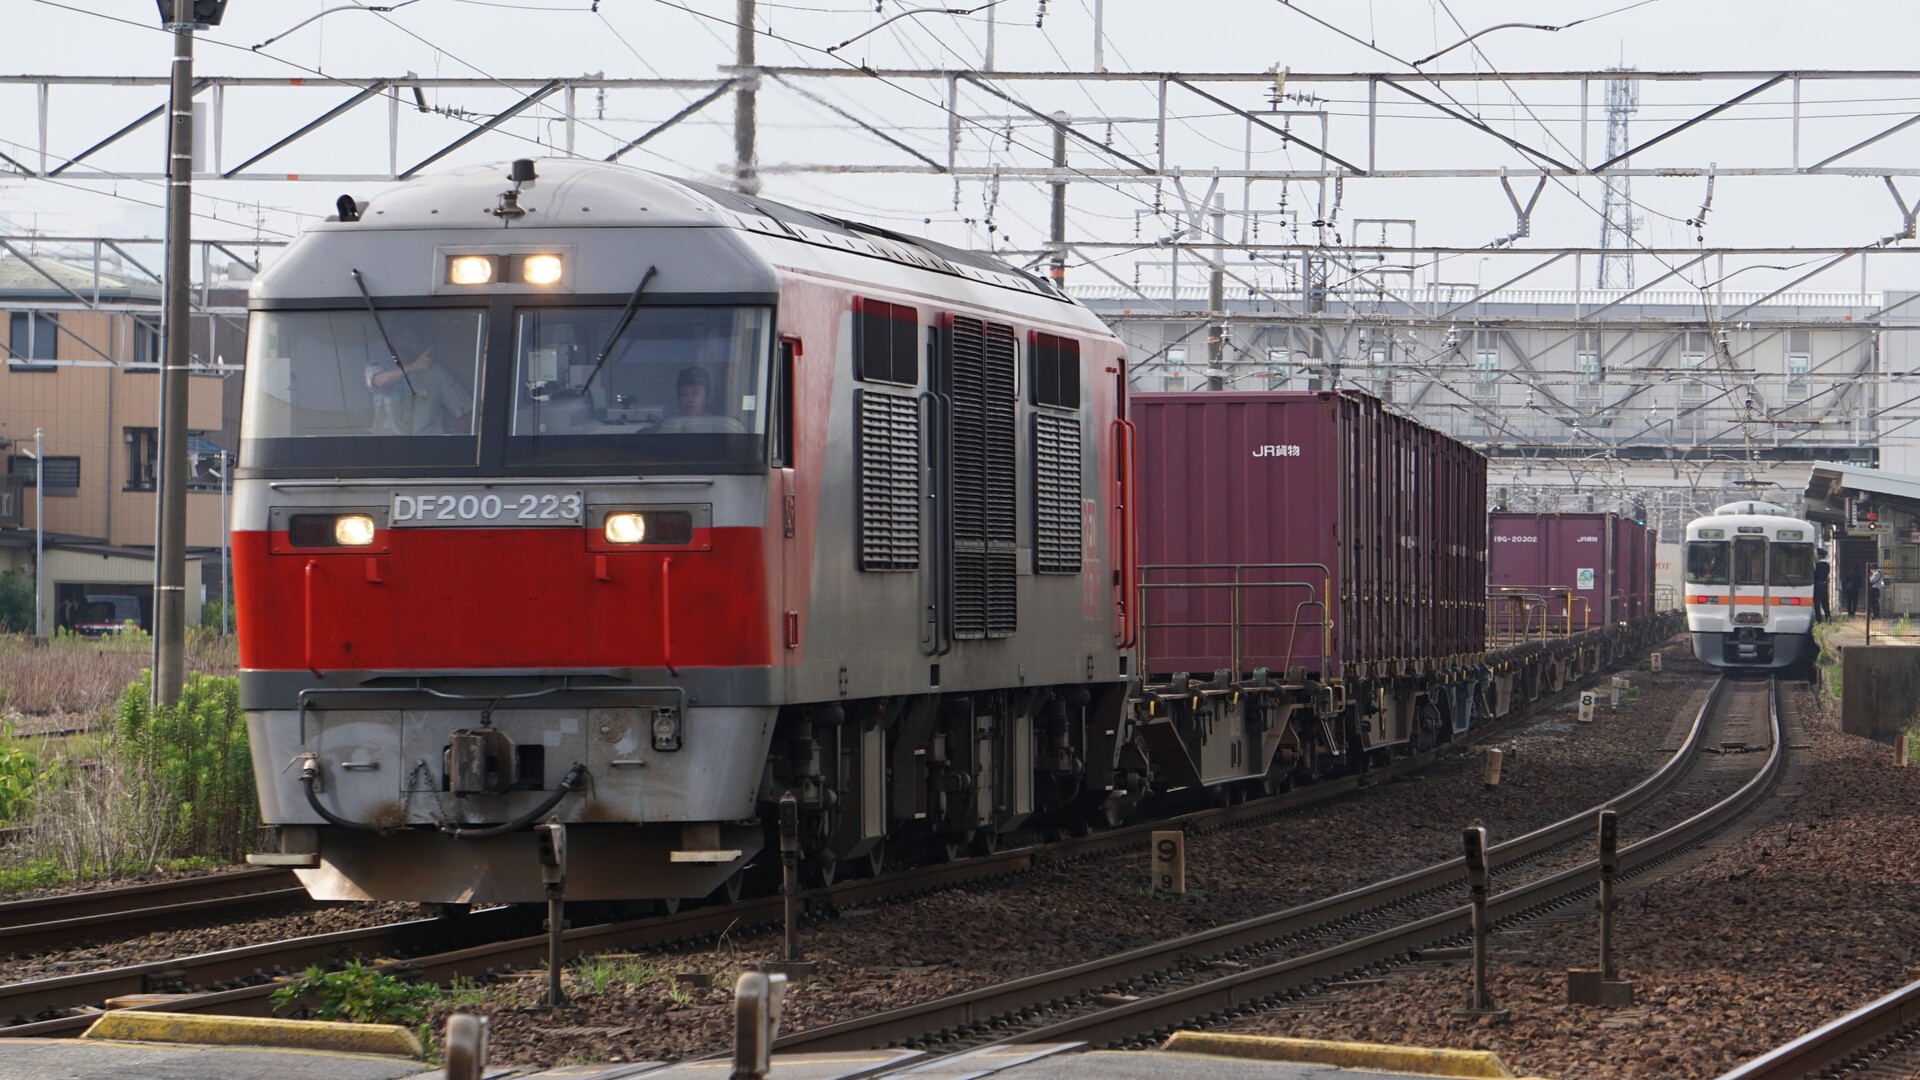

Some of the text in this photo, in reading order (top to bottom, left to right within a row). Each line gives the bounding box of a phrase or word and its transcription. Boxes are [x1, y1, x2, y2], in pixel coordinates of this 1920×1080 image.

[1252, 444, 1300, 457] JR貨物
[393, 494, 581, 521] DF200-223
[1493, 535, 1538, 543] 19G-20302
[1652, 655, 1659, 663] 7
[1582, 695, 1592, 706] 8
[1157, 839, 1177, 863] 9
[1162, 875, 1172, 889] 9
